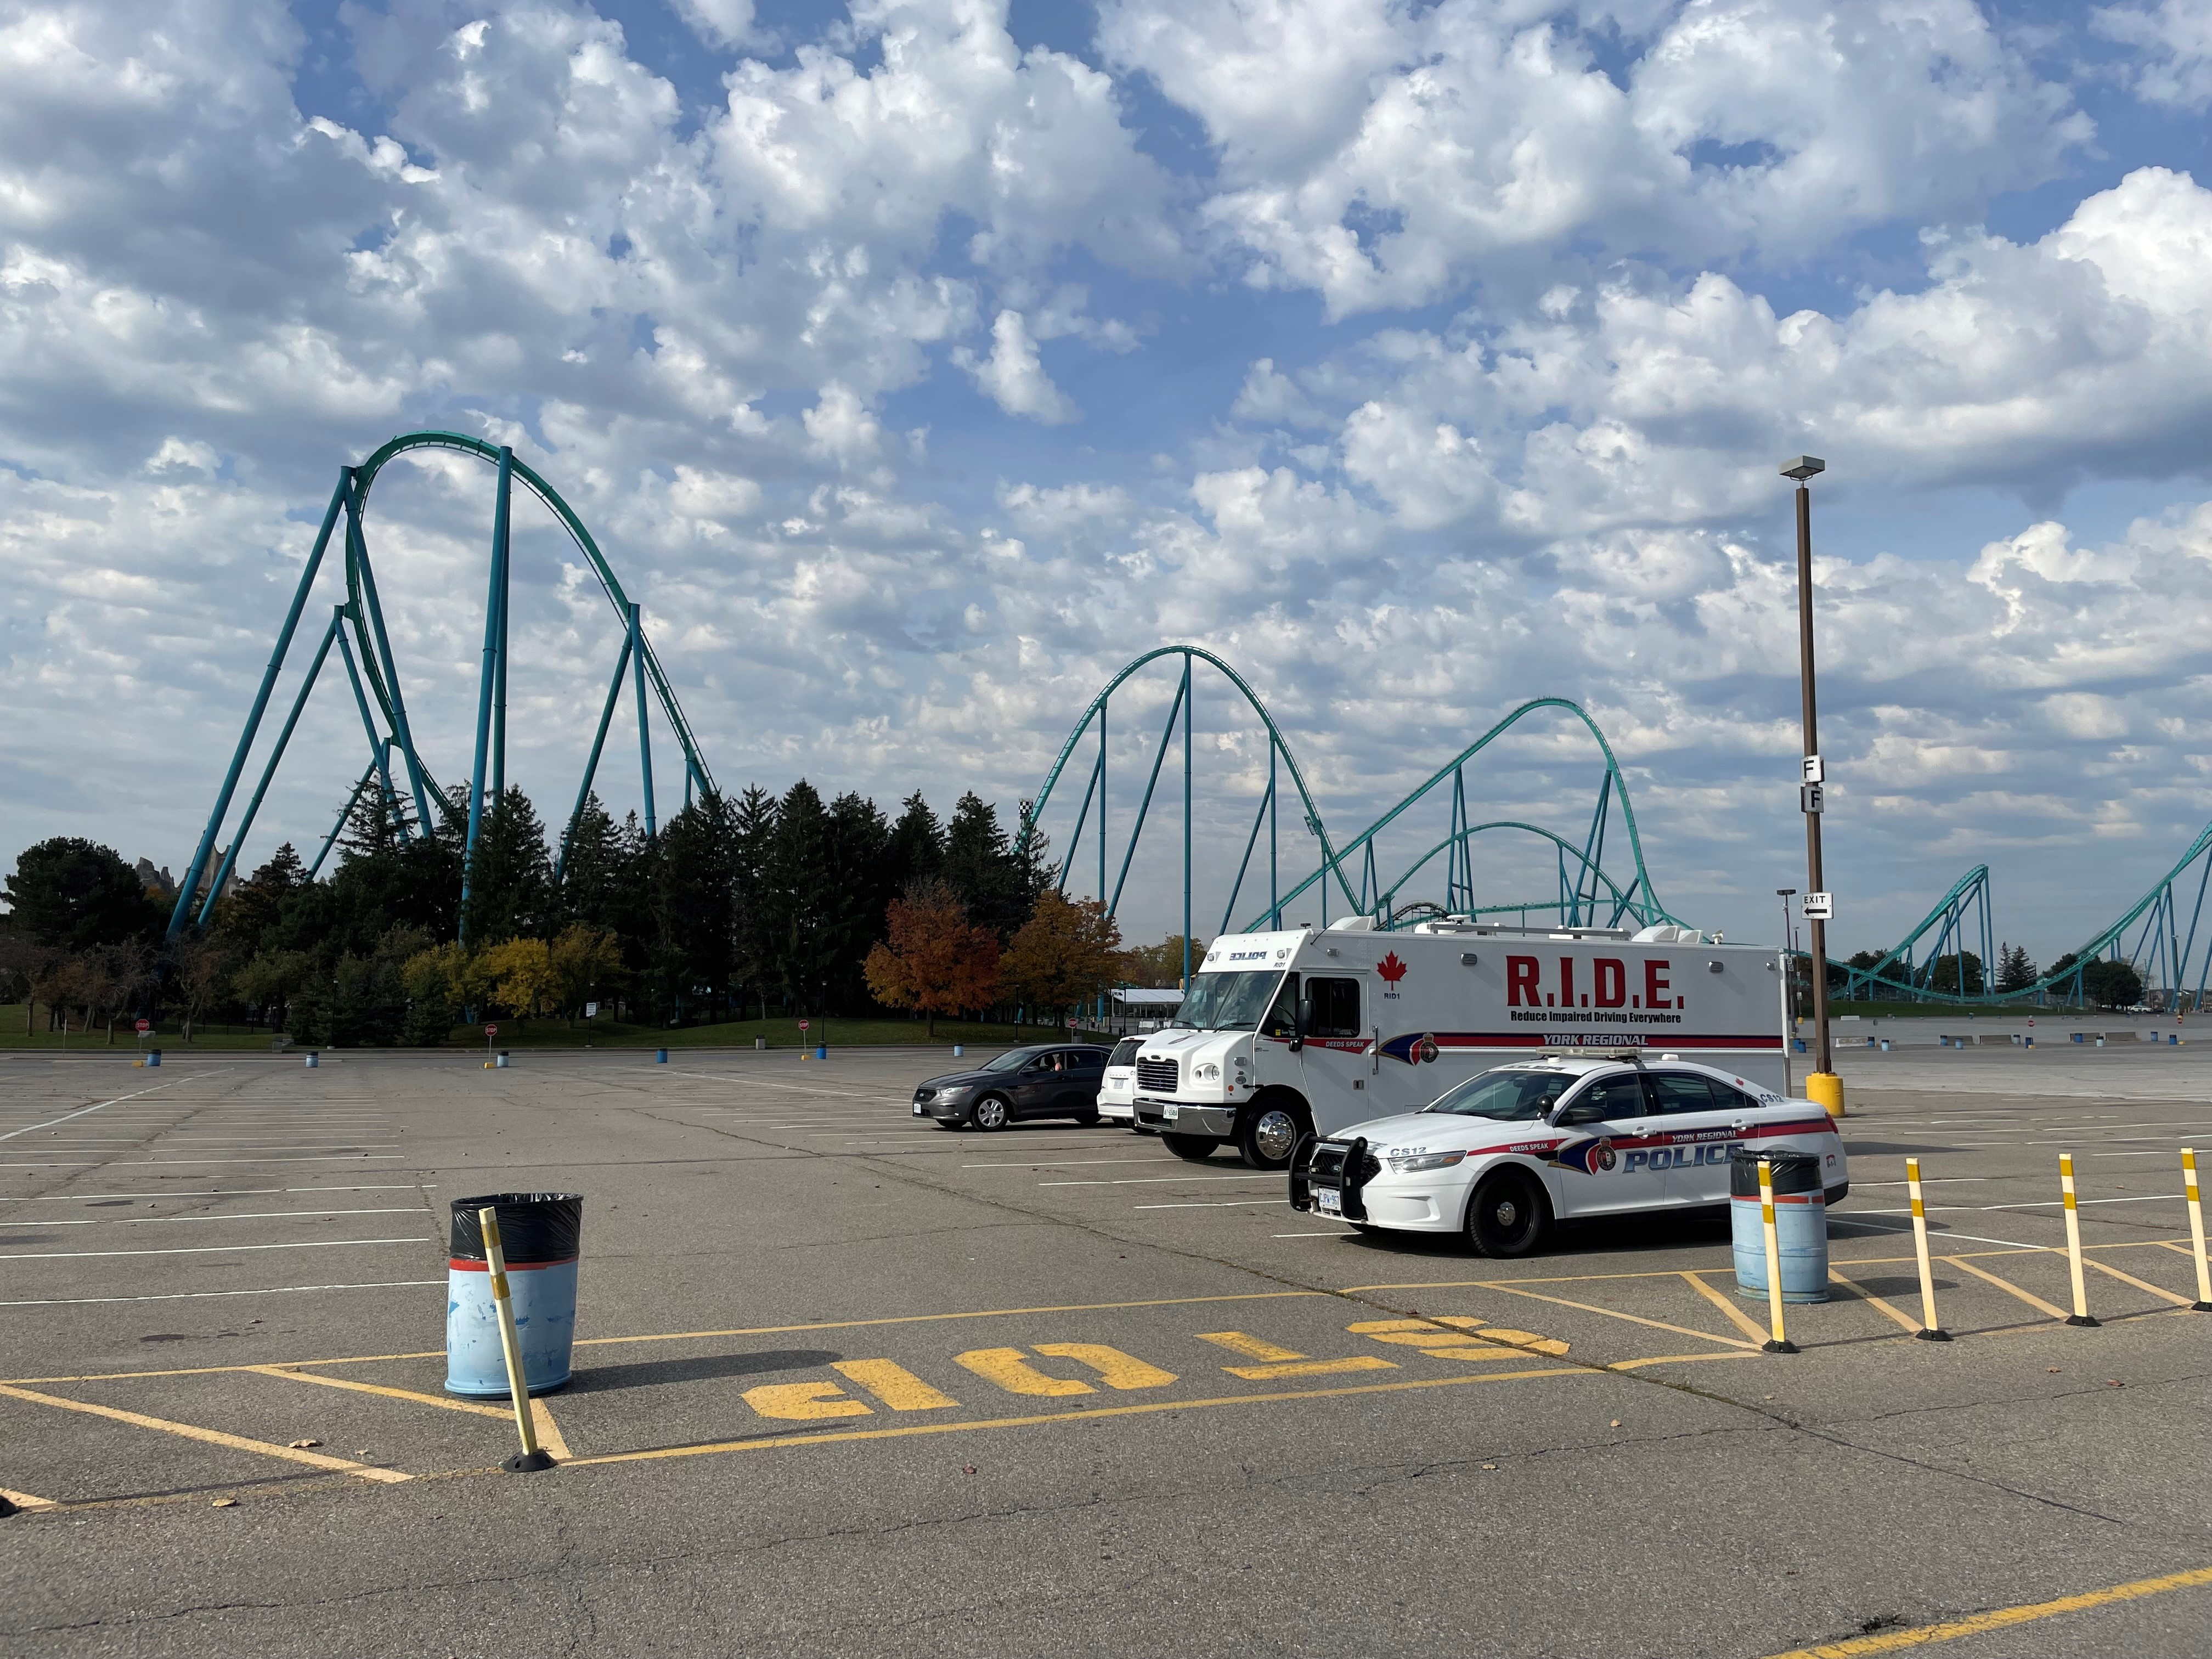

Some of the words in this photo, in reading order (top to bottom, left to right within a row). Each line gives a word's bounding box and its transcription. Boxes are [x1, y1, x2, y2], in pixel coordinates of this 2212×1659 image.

[1803, 759, 1815, 779] F
[1811, 790, 1821, 808] F
[1804, 895, 1826, 904] EXIT
[1506, 955, 1684, 1009] R.I.D.E.
[1511, 1011, 1547, 1022] Reduce
[1549, 1011, 1592, 1023] Impaired
[1594, 1012, 1627, 1023] Driving
[1629, 1012, 1681, 1024] Everywhere
[1543, 1035, 1579, 1046] YORK
[1583, 1035, 1649, 1046] REGIONAL
[1760, 1094, 1785, 1103] CS12
[1672, 1134, 1695, 1143] YORK
[1696, 1130, 1737, 1141] REGIONAL
[1390, 1147, 1427, 1156] CS12
[1530, 1142, 1549, 1150] SPEAK
